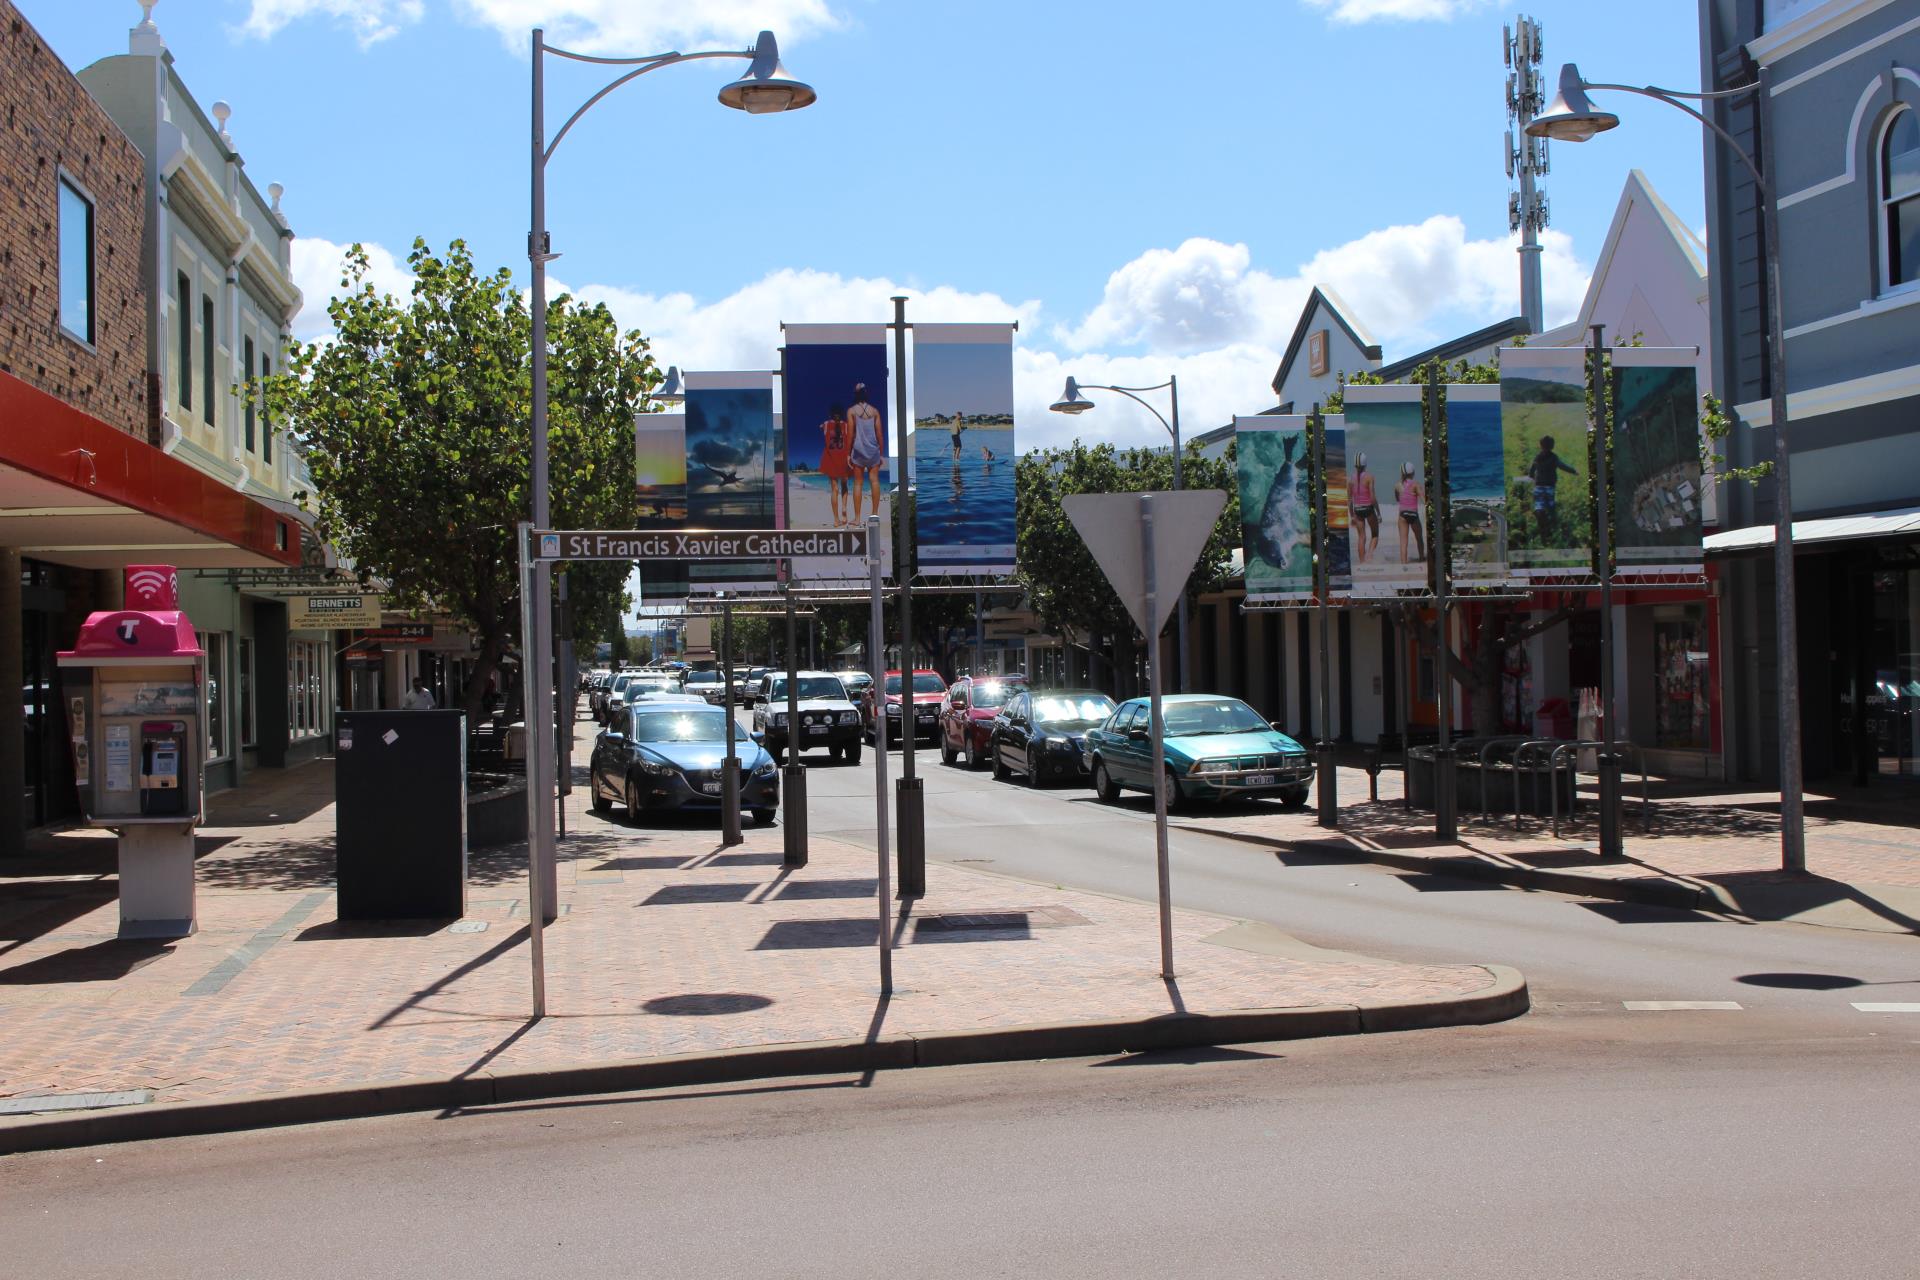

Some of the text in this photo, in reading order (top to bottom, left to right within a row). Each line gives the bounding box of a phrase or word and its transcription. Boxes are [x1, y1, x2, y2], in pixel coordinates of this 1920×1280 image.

[569, 533, 844, 556] St Francis Xavier Cathedral
[310, 599, 361, 608] BENNETTS
[121, 620, 140, 639] T
[402, 626, 424, 636] 2-4-1
